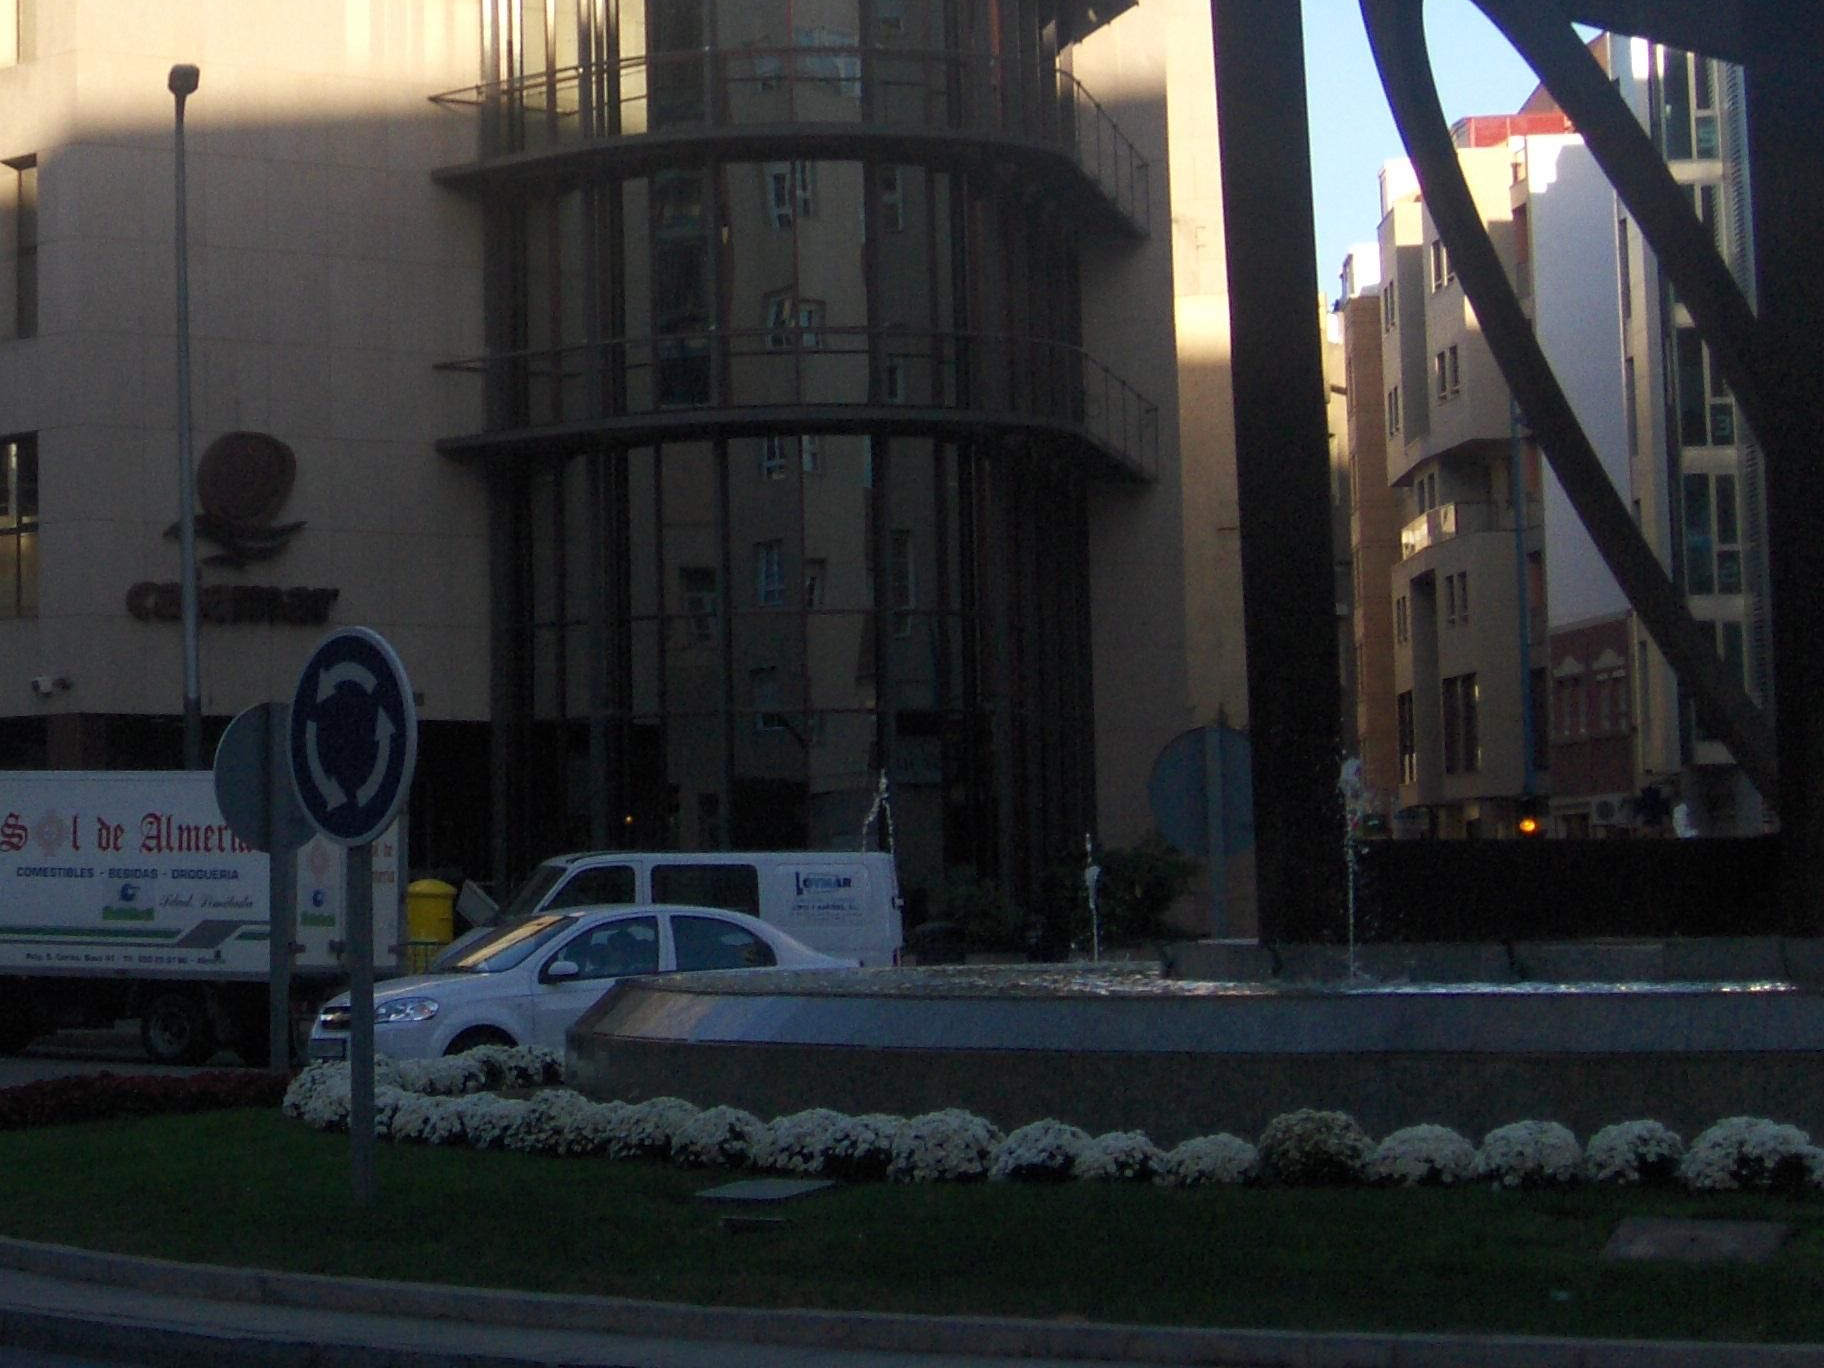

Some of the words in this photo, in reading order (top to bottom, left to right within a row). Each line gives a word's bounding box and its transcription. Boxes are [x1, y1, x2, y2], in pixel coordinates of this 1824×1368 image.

[126, 569, 339, 625] caamar
[97, 817, 125, 852] de
[139, 812, 253, 853] Almeri
[16, 866, 95, 879] COMESTIBLES
[108, 867, 158, 880] BEBIDAS
[171, 868, 240, 881] DROGUERIA
